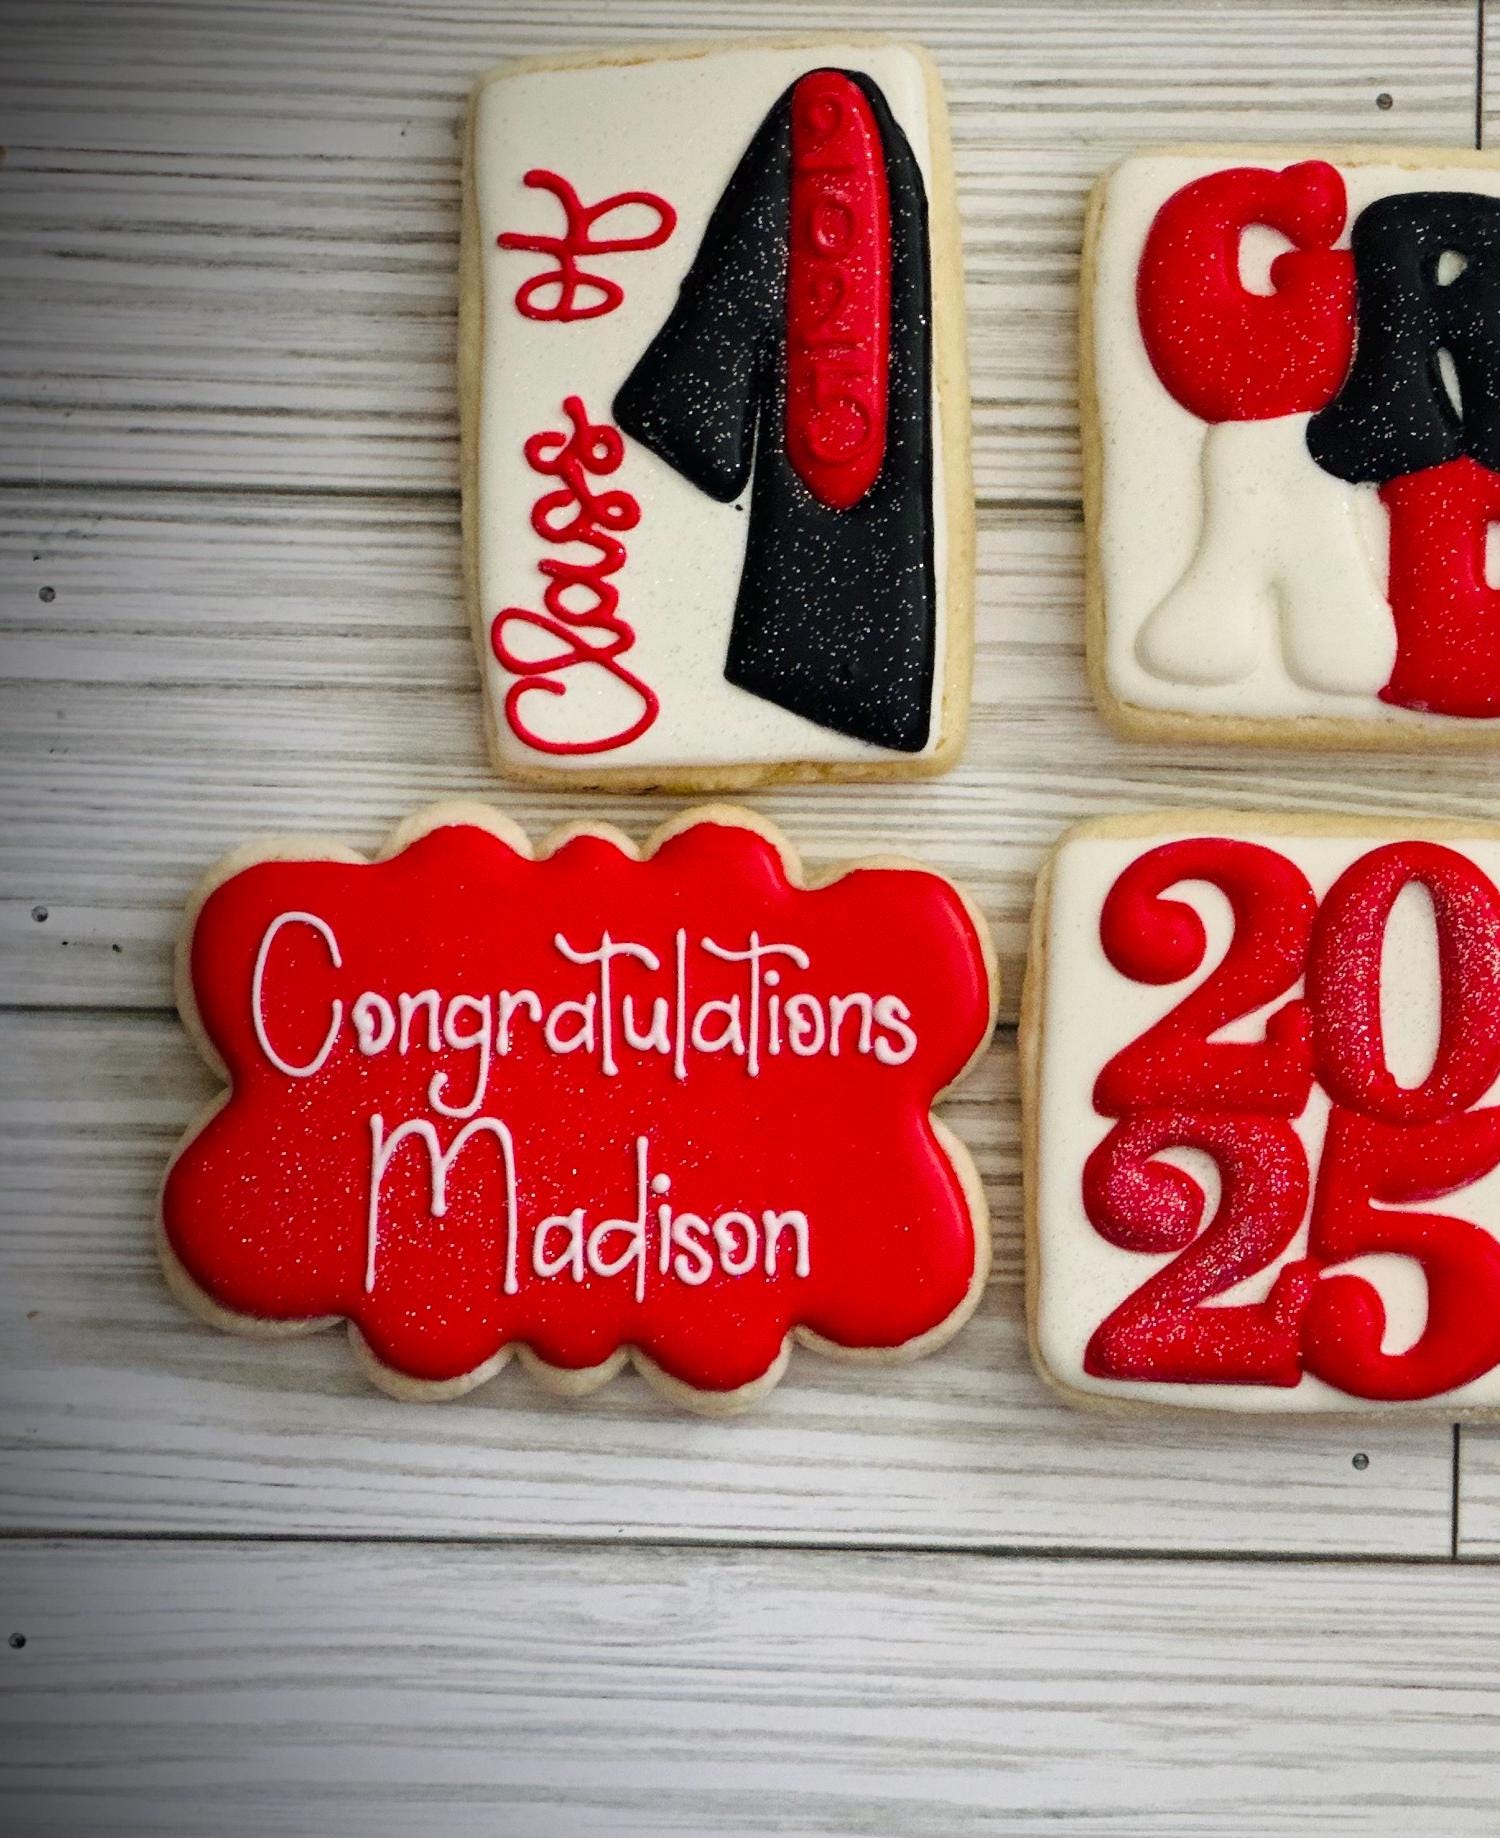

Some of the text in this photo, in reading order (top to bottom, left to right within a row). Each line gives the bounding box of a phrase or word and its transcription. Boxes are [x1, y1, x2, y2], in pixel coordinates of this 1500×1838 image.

[491, 395, 660, 755] Class
[252, 911, 918, 1118] Congratulations
[364, 1113, 810, 1303] Madison
